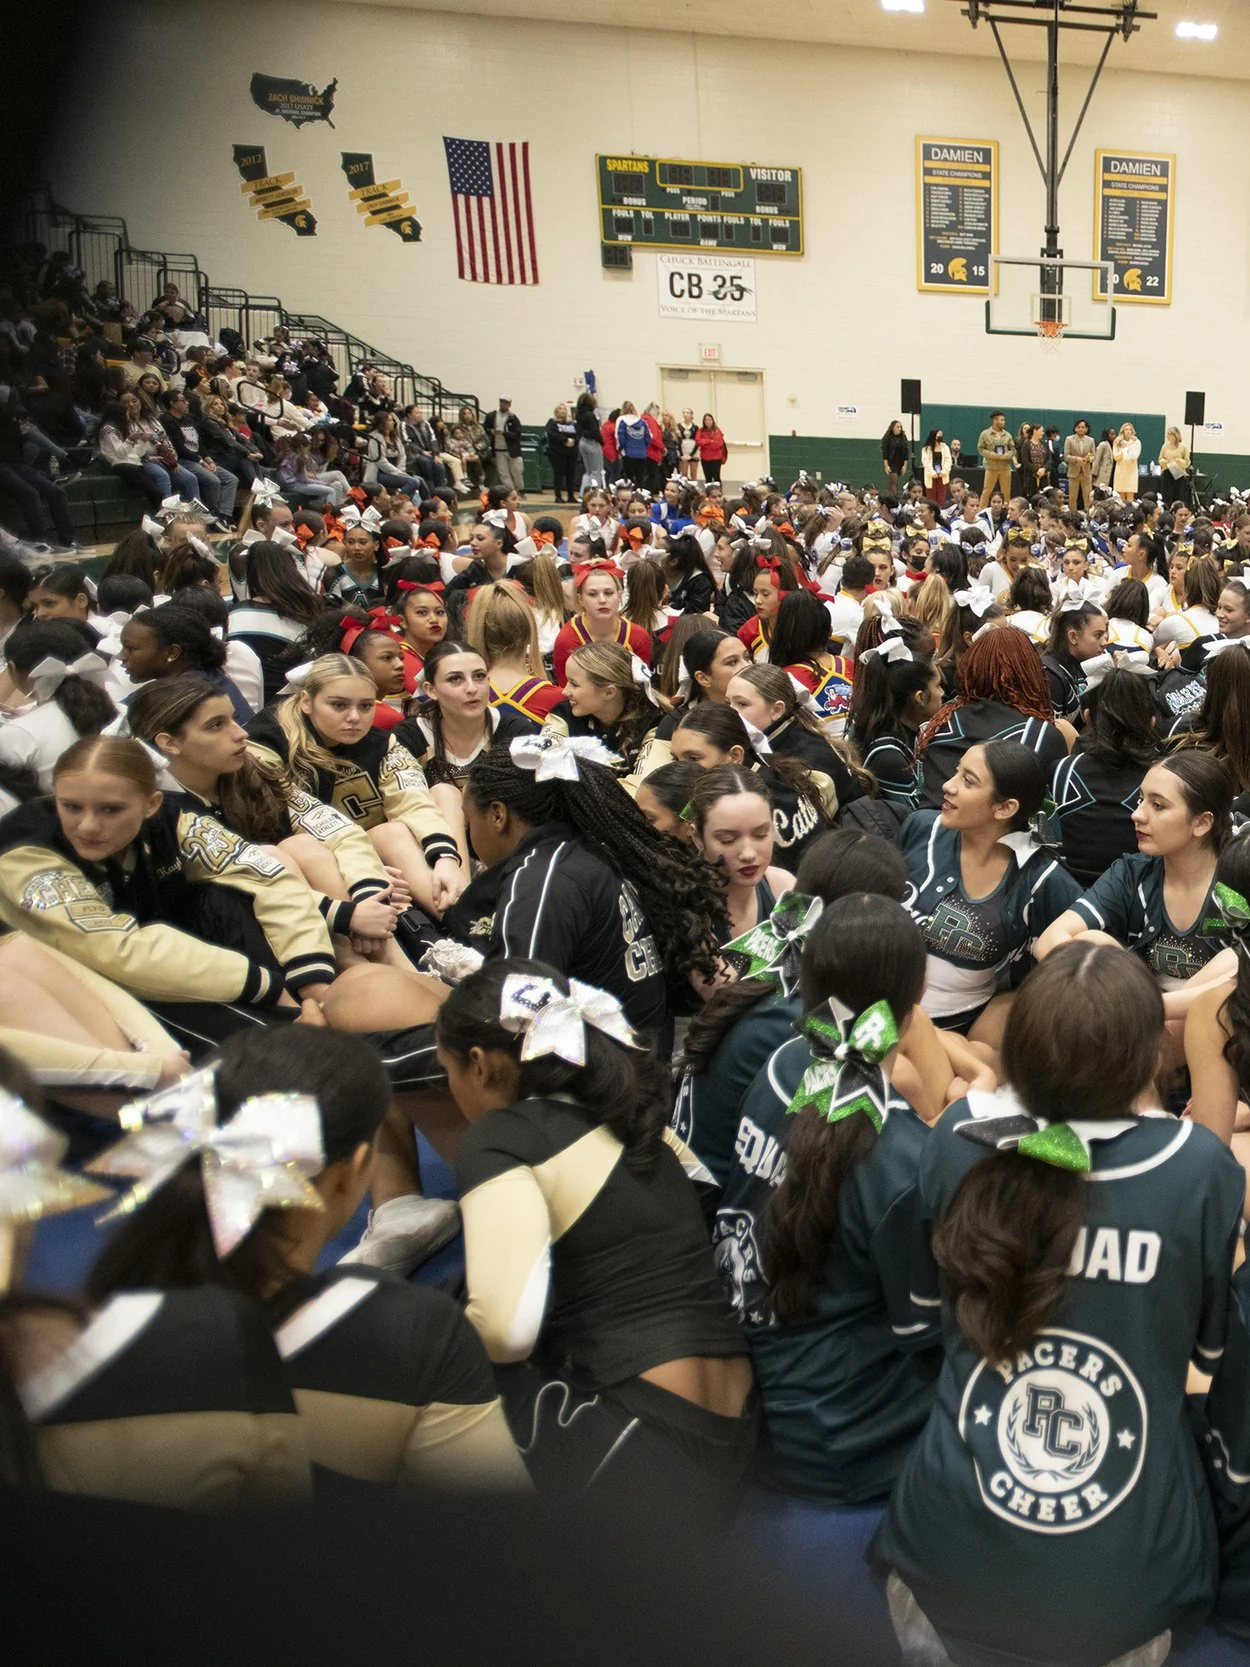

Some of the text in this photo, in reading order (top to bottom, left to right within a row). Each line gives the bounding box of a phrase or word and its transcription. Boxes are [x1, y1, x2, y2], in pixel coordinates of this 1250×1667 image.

[268, 93, 325, 106] ZACH SHINNICK
[240, 153, 263, 168] 2012
[931, 147, 984, 164] DAMIEN
[348, 161, 370, 175] 2017
[606, 159, 649, 174] SPARTANS
[1110, 160, 1161, 176] DAMIEN
[749, 167, 792, 182] VISITOR
[932, 169, 982, 179] STATE CHAMPIONS
[252, 177, 281, 190] TRACK
[1128, 183, 1160, 191] CHAMPIONS
[360, 184, 389, 197] TRACK
[623, 197, 647, 206] BONUS
[682, 196, 708, 206] PERIOD
[612, 208, 635, 218] FOULS
[664, 211, 690, 221] PLAYER
[755, 205, 779, 215] BONUS
[697, 213, 721, 223] POINTS
[723, 214, 745, 225] FOULS
[768, 218, 790, 227] FOULS
[660, 254, 695, 266] CHUCK
[930, 262, 944, 274] 20
[972, 265, 986, 277] 15
[669, 271, 745, 302] CB 35
[1146, 275, 1159, 287] 22
[661, 305, 685, 313] VOICE
[701, 307, 716, 315] THE
[718, 308, 756, 317] SPARTANS
[705, 348, 717, 357] EXIT
[924, 903, 983, 958] PC
[735, 1116, 787, 1187] SQUA
[1069, 1227, 1160, 1283] UAD
[996, 1342, 1122, 1397] PACERS
[1023, 1383, 1083, 1459] PC
[989, 1472, 1108, 1522] CHEER
